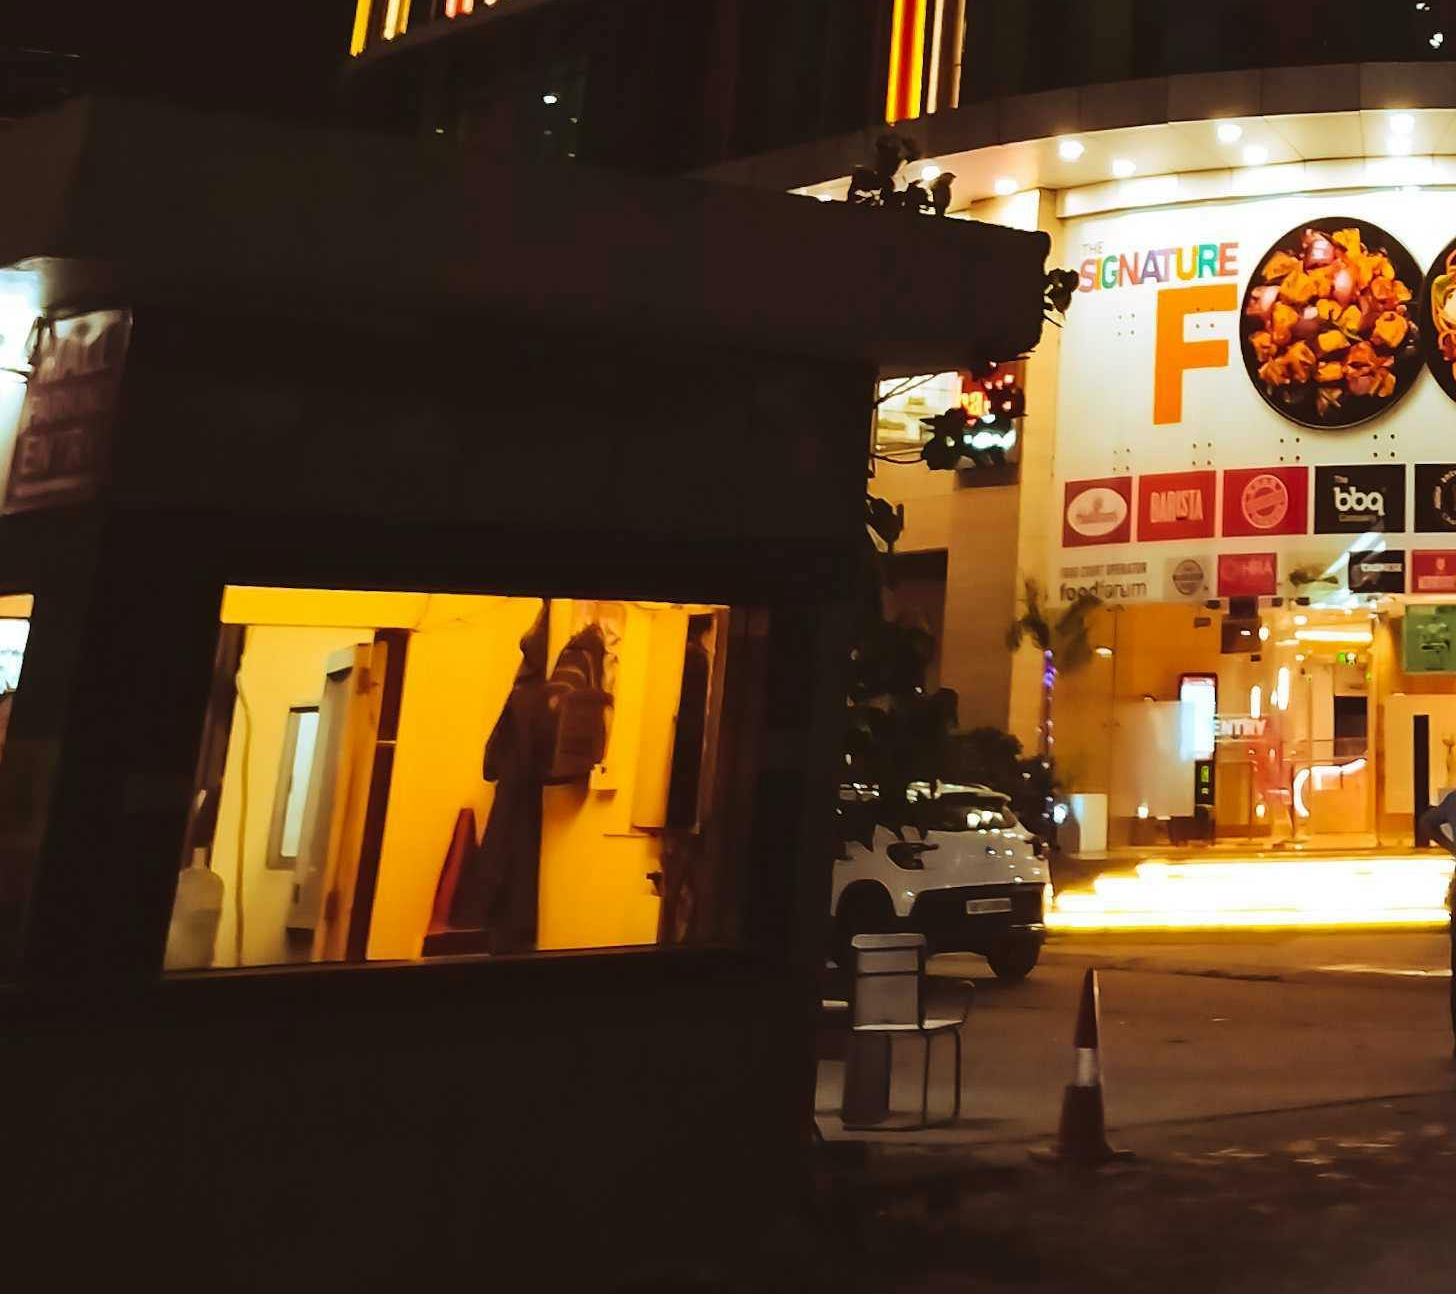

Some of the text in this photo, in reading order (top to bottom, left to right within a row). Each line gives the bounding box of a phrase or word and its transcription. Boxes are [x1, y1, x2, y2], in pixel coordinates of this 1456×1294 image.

[1078, 242, 1239, 293] SIGNATURE
[1150, 489, 1204, 523] BARISTA
[1334, 486, 1385, 516] bbq
